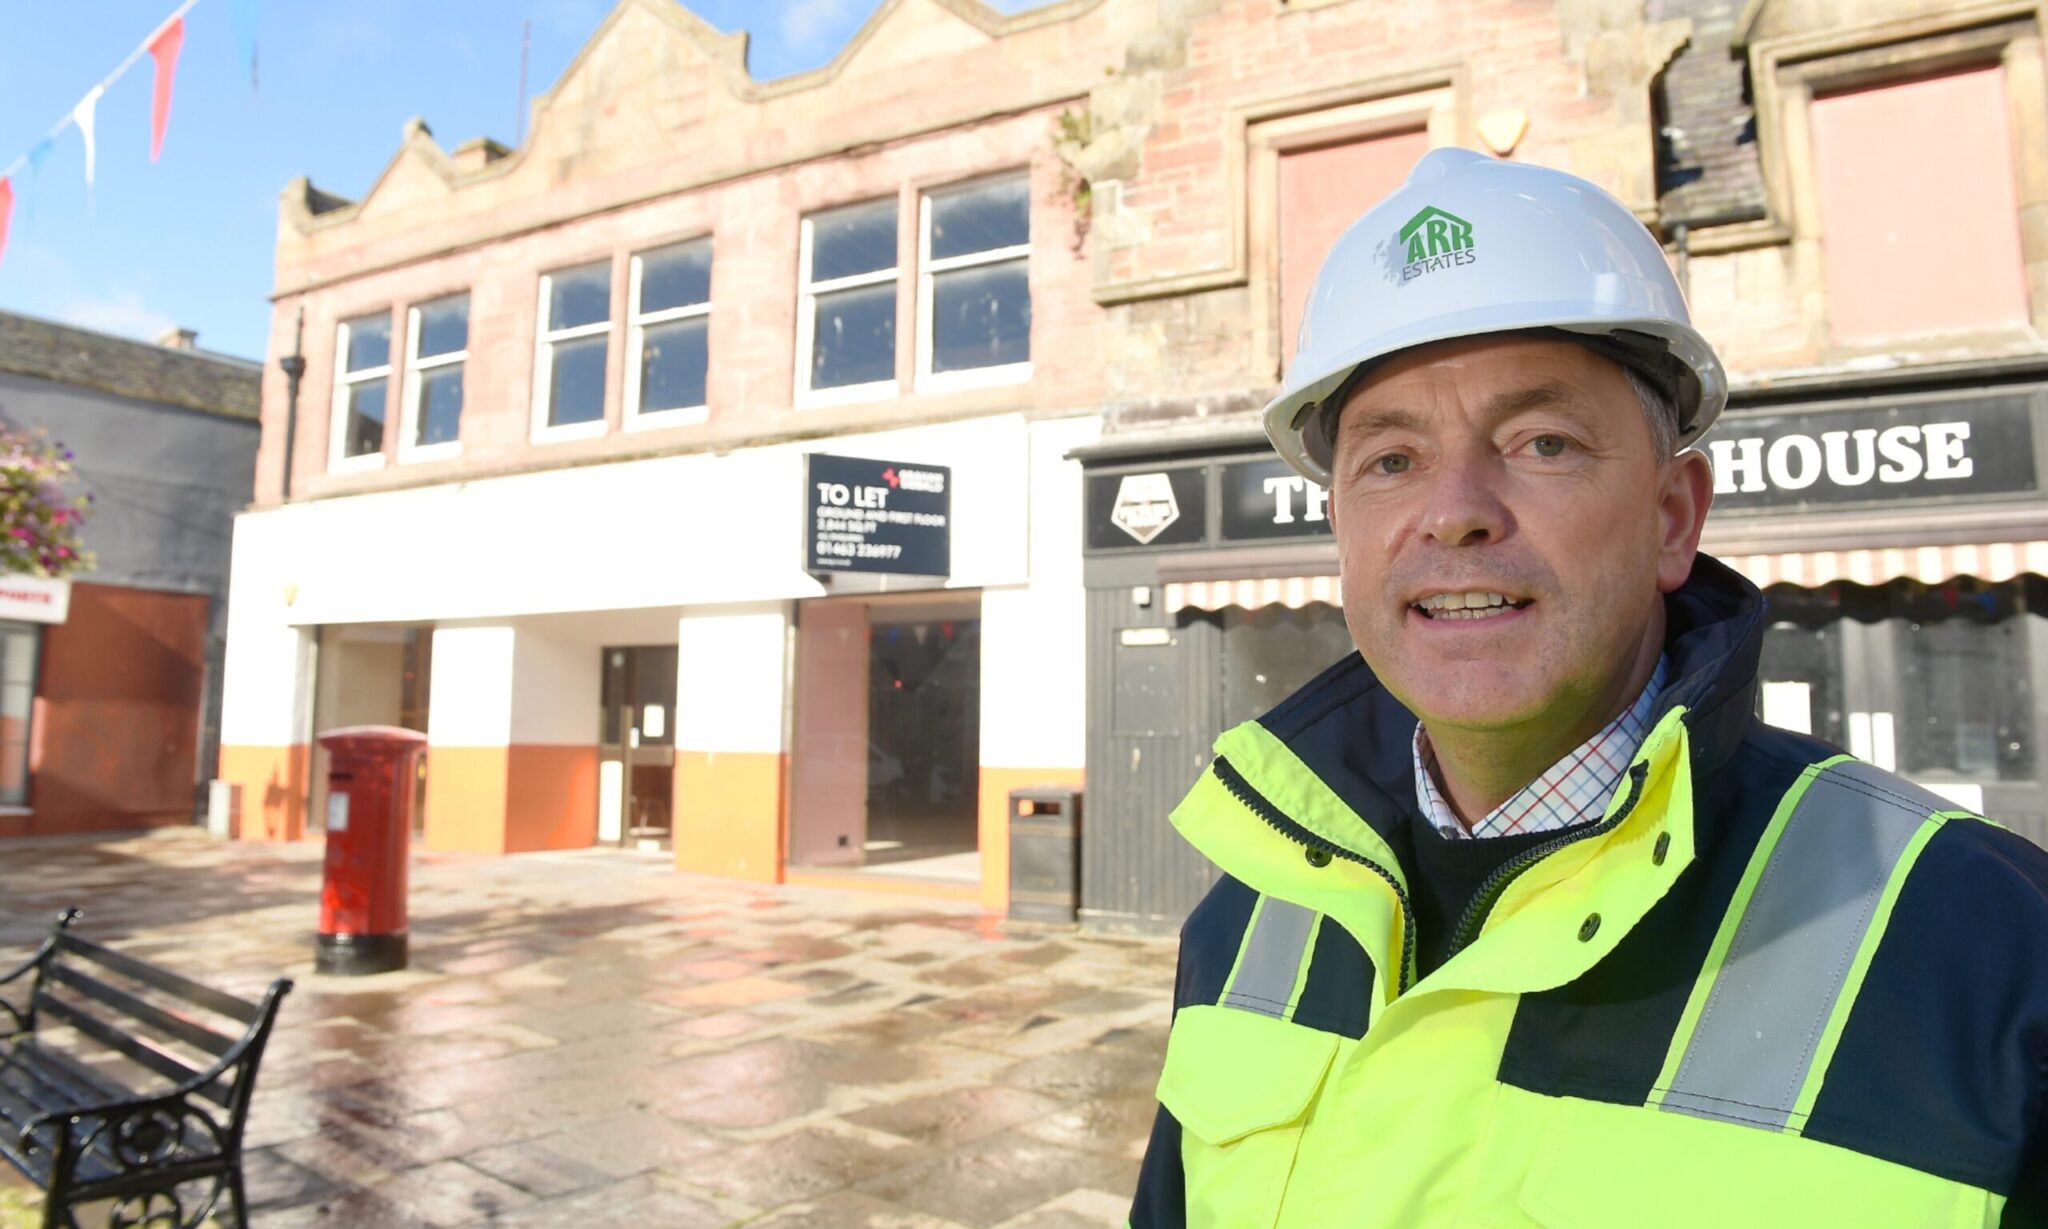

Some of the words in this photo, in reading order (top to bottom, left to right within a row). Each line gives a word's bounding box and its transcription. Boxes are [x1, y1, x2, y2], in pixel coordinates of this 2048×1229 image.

[1407, 219, 1474, 264] ARR
[1402, 249, 1476, 281] ESTATES
[1709, 421, 1974, 494] HOUSE
[817, 482, 850, 506] TO
[854, 485, 889, 508] LET
[816, 505, 864, 521] GROUND
[864, 509, 888, 523] AND
[914, 513, 945, 527] FLOOR
